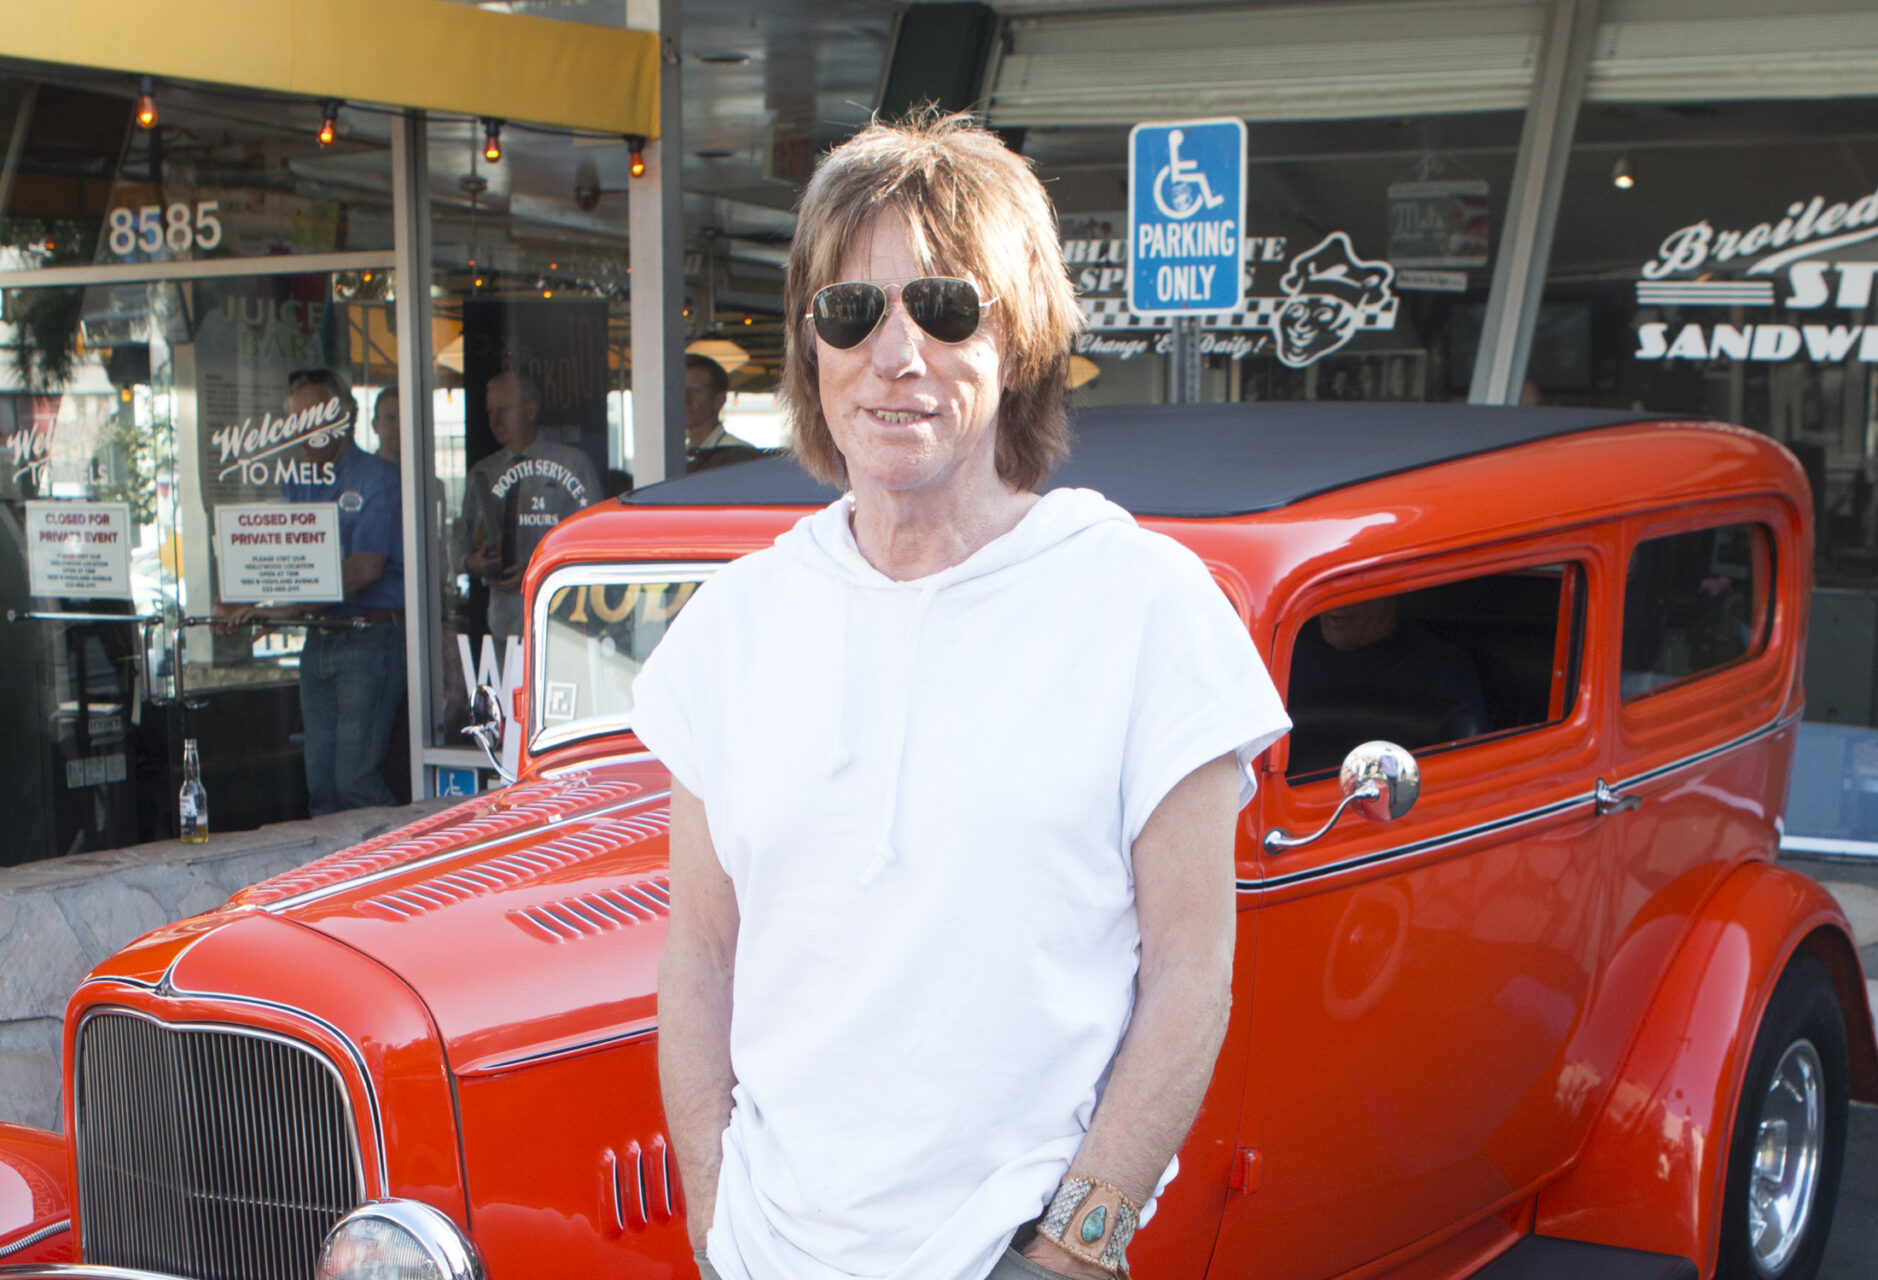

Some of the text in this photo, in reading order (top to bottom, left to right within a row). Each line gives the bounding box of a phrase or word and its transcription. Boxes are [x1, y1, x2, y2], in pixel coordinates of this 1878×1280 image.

[109, 200, 222, 254] 8585
[1138, 219, 1236, 259] PARKING
[1063, 238, 1128, 264] BLU
[1157, 264, 1216, 302] ONLY
[1784, 261, 1878, 309] ST
[221, 295, 325, 329] JUICE
[1078, 333, 1149, 361] Change
[212, 396, 341, 463] Welcome
[238, 459, 269, 485] TO
[491, 459, 586, 499] BOOTH SERVICE
[531, 496, 545, 510] 24
[45, 512, 110, 525] CLOSED FOR
[238, 513, 317, 526] CLOSED FOR
[519, 513, 559, 526] HOURS
[84, 531, 118, 543] EVENT
[231, 531, 326, 545] PRIVATE EVENT
